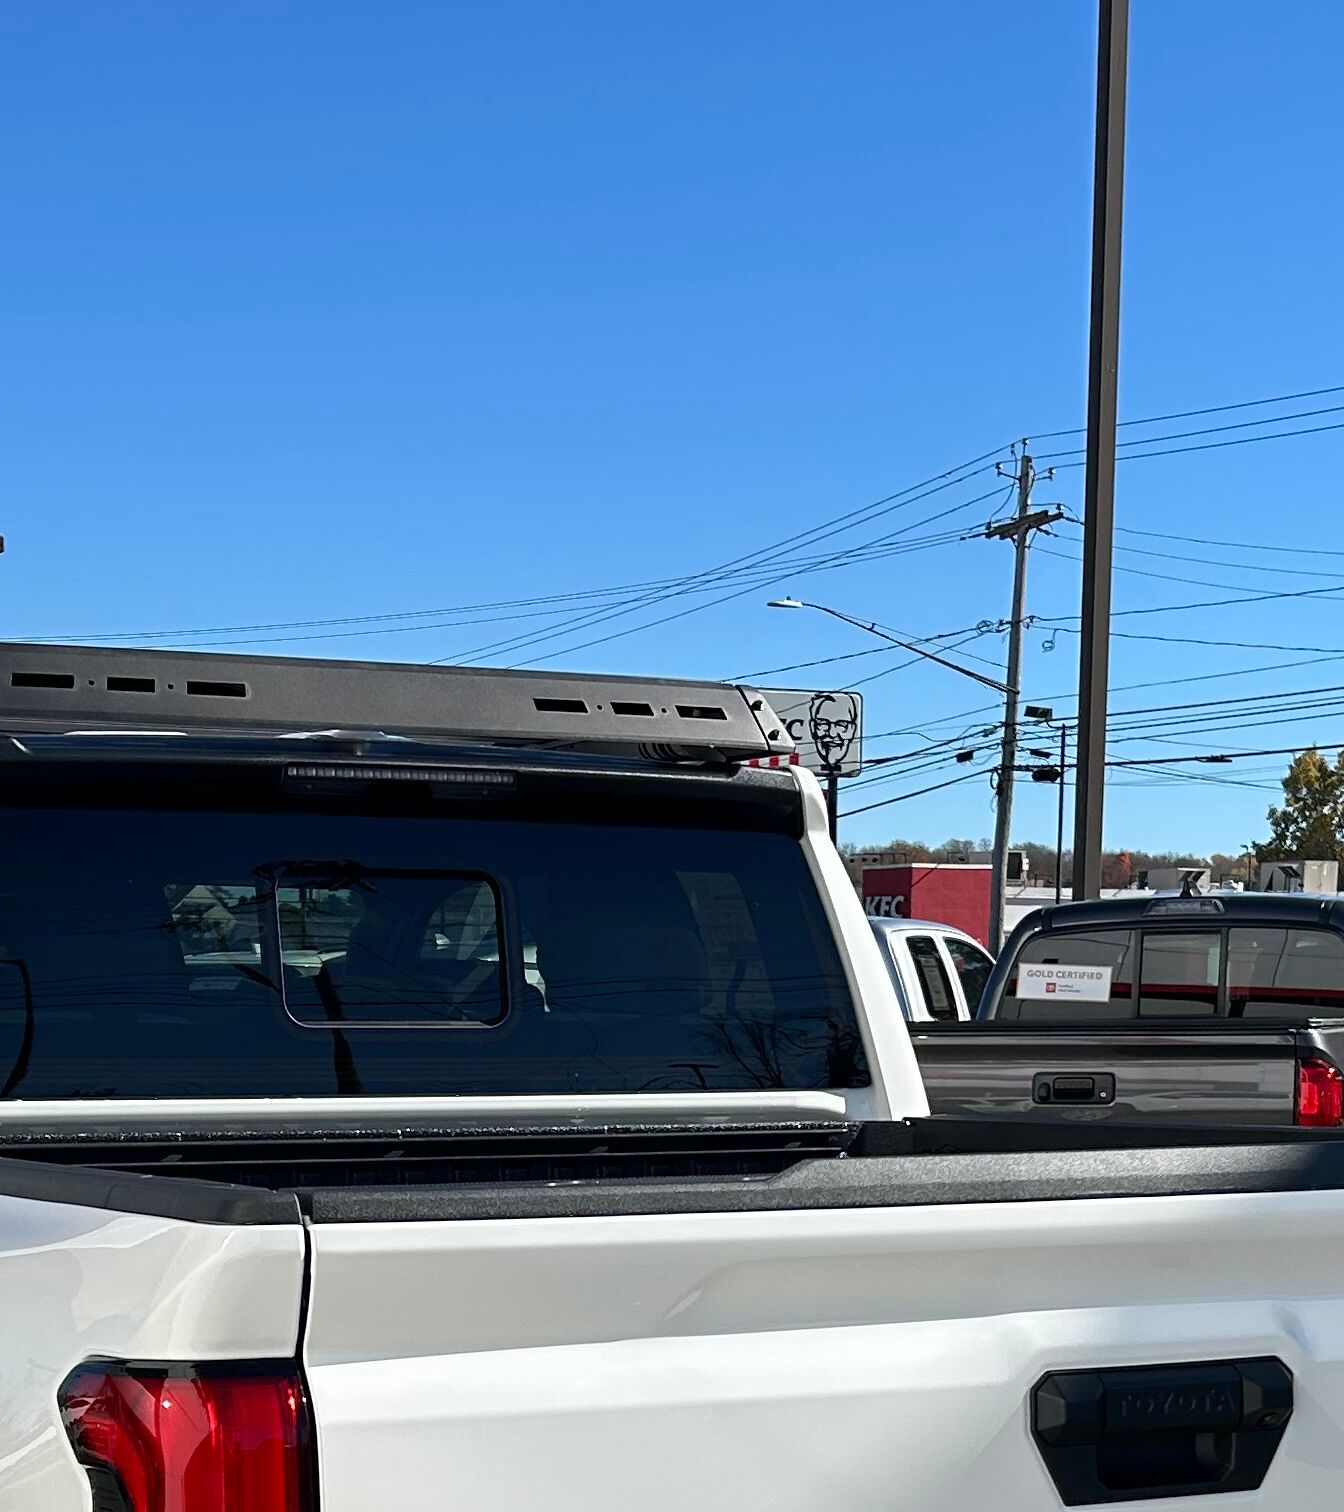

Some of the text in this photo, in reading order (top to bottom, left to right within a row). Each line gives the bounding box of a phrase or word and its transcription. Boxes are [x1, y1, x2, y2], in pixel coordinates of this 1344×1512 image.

[865, 895, 905, 917] KFC
[1027, 970, 1103, 980] GOLD CERTIFIED
